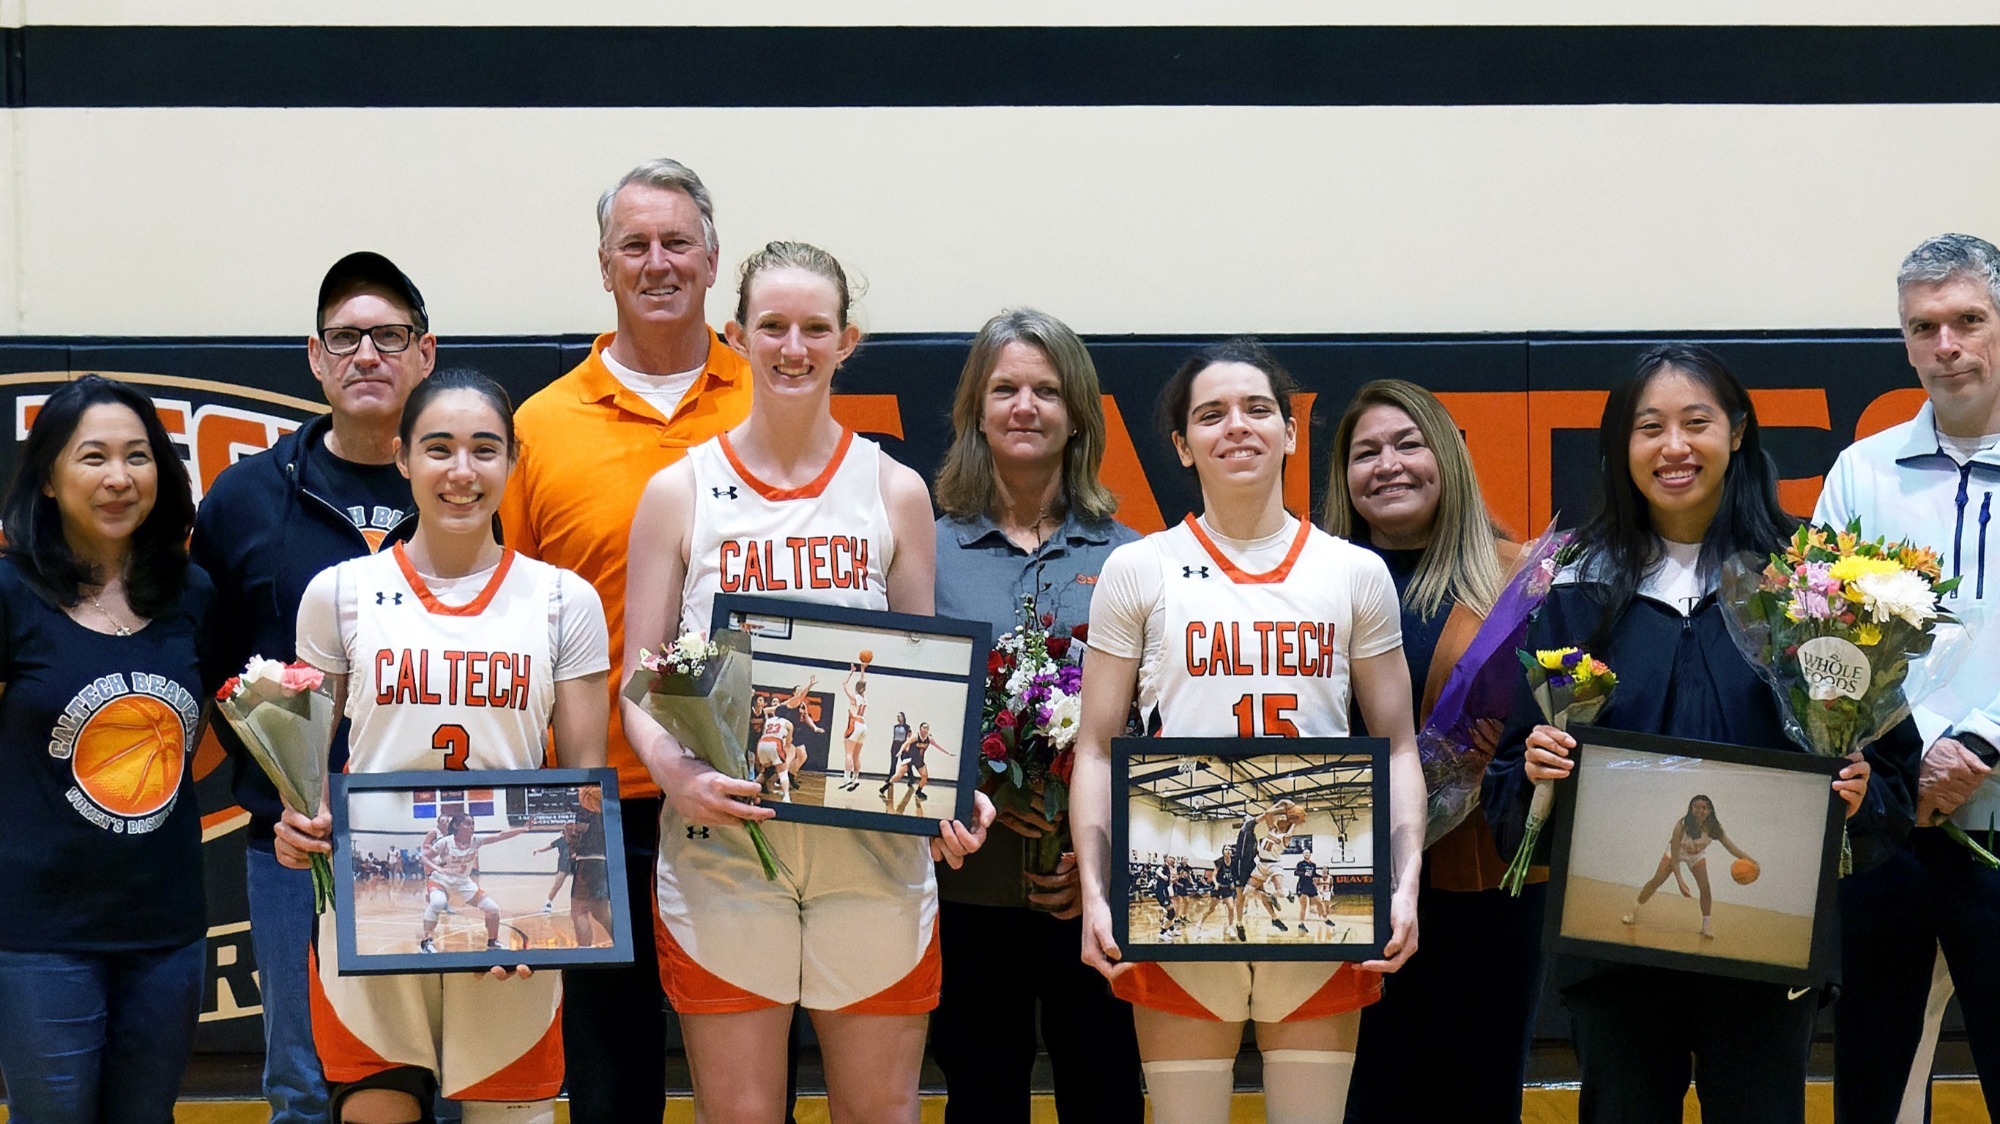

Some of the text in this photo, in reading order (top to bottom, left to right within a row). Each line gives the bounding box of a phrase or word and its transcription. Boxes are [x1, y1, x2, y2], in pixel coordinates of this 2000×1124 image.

[720, 535, 868, 592] CALTECH
[1186, 621, 1335, 678] CALTECH
[1804, 651, 1863, 680] WHOLE
[375, 648, 531, 710] CALTECH
[1804, 666, 1858, 694] FOODS
[49, 673, 129, 759] CALTECH
[1233, 693, 1300, 738] 15
[431, 723, 470, 771] 3
[65, 786, 124, 833] WOMEN'S
